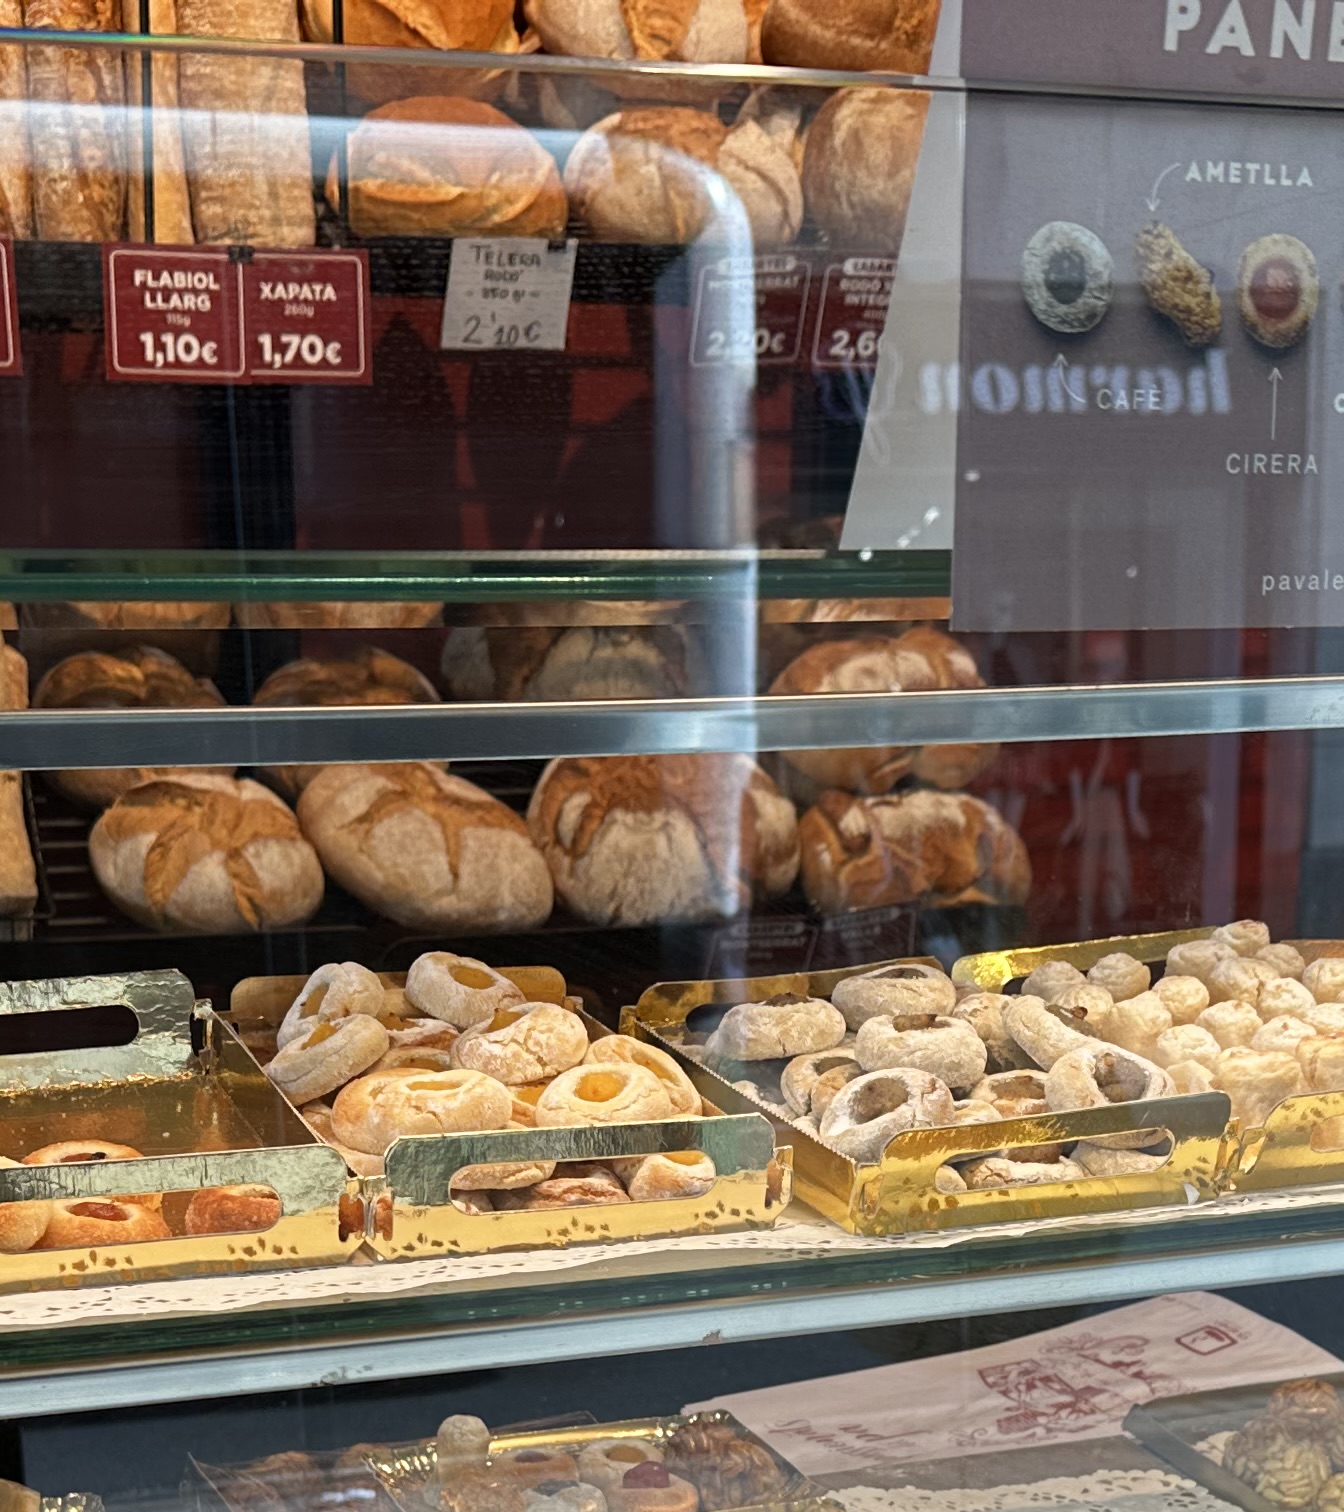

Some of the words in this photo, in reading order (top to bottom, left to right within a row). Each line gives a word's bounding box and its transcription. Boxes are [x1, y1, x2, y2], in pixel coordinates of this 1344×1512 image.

[1185, 160, 1315, 187] AMETLLA
[133, 269, 221, 291] FLABIOL
[259, 281, 338, 301] XAPATA
[144, 291, 212, 312] LLARG
[139, 332, 218, 368] 1,10€
[257, 333, 343, 369] 1,70€
[1225, 453, 1319, 475] CIRERA
